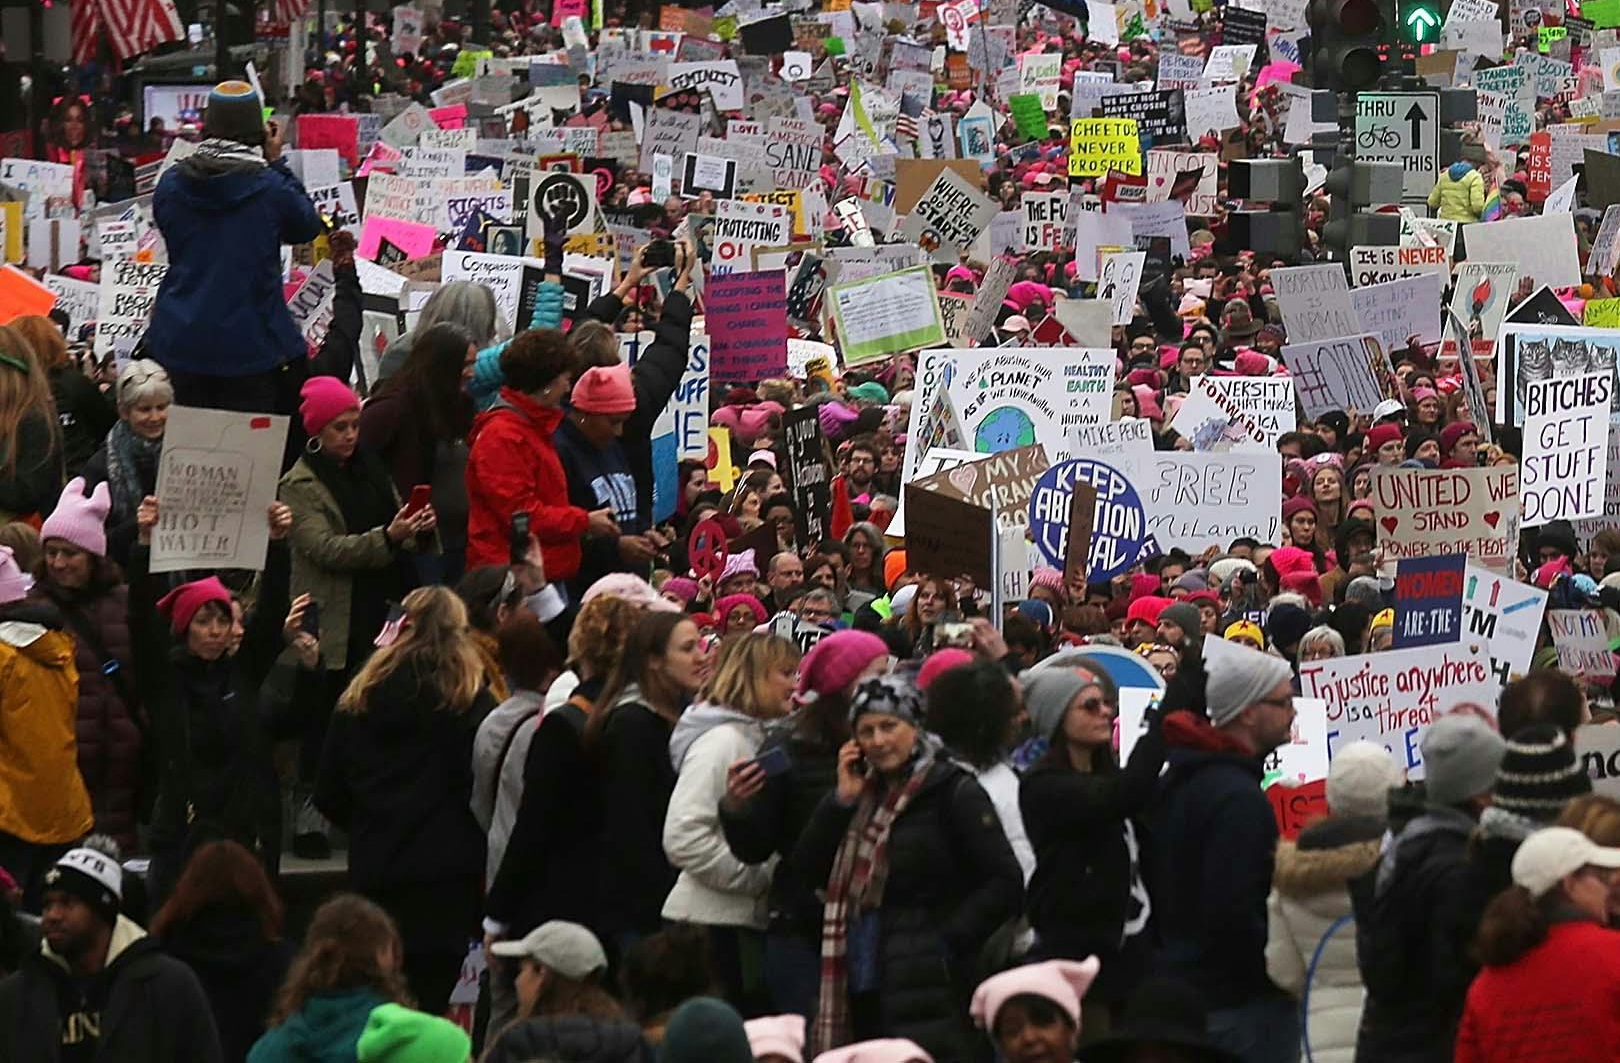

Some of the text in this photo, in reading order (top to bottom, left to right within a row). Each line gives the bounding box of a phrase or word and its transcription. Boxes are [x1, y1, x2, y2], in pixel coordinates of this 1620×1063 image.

[1476, 67, 1525, 82] STANDING
[1538, 60, 1570, 76] BODY
[670, 73, 740, 88] FEMINIST
[1357, 100, 1395, 117] THRU
[732, 125, 758, 134] LOVE
[768, 131, 821, 145] AMERICA
[1074, 123, 1137, 137] CHEETOS
[766, 142, 822, 172] SANE
[1078, 142, 1126, 154] NEVER
[1402, 155, 1433, 171] THIS
[1532, 155, 1541, 166] IS
[448, 196, 506, 216] RIGHTS
[934, 177, 980, 220] WHERE
[1025, 201, 1047, 221] THE
[716, 218, 780, 241] PROTECTING
[916, 201, 973, 249] START?!
[1026, 226, 1037, 245] IS
[1357, 248, 1445, 265] It is NEVER
[1275, 269, 1344, 291] ABORTION
[990, 372, 1042, 388] PLANET
[1064, 365, 1110, 378] HEALTHY
[1066, 379, 1107, 393] EARTH
[1528, 376, 1611, 416] BITCHES
[1061, 414, 1099, 425] HUMAN
[1198, 377, 1265, 443] FORWARD
[1077, 426, 1112, 448] MIKE
[1540, 416, 1592, 449] GET
[169, 464, 238, 479] WOMAN
[985, 455, 1020, 482] MY
[1524, 446, 1601, 484] STUFF
[1151, 460, 1255, 506] FREE
[1377, 471, 1516, 509] UNITED WE
[1522, 478, 1598, 521] DONE
[159, 512, 227, 531] HOT
[1413, 511, 1469, 531] STAND
[159, 535, 229, 553] WATER
[1381, 539, 1474, 556] POWER TO THE
[1397, 569, 1463, 599] WOMEN
[1403, 609, 1452, 636] ARE THE
[1552, 614, 1599, 636] NOT MY
[1557, 648, 1613, 669] PRESIDENT
[1302, 654, 1486, 720] Injustice anywhere
[1375, 695, 1439, 735] threat
